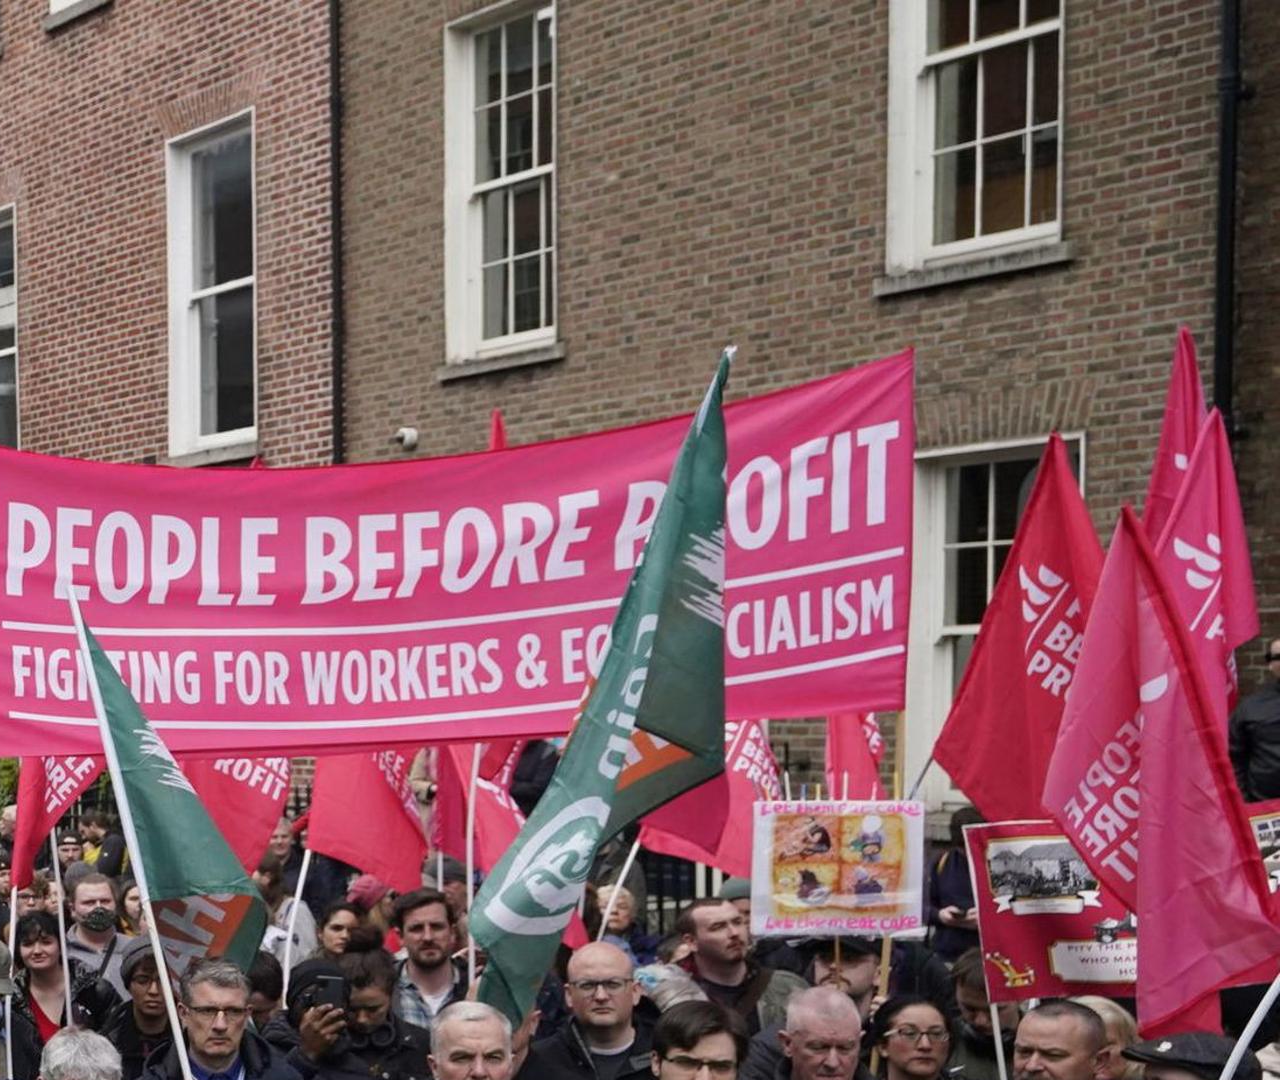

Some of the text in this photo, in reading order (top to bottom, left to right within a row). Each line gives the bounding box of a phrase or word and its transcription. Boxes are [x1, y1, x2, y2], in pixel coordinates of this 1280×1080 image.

[6, 420, 900, 606] PEOPLE BEFORE POFIT
[213, 651, 290, 705] FOR
[302, 633, 503, 706] WORKERS
[515, 634, 548, 689] &
[1080, 956, 1109, 965] WHO
